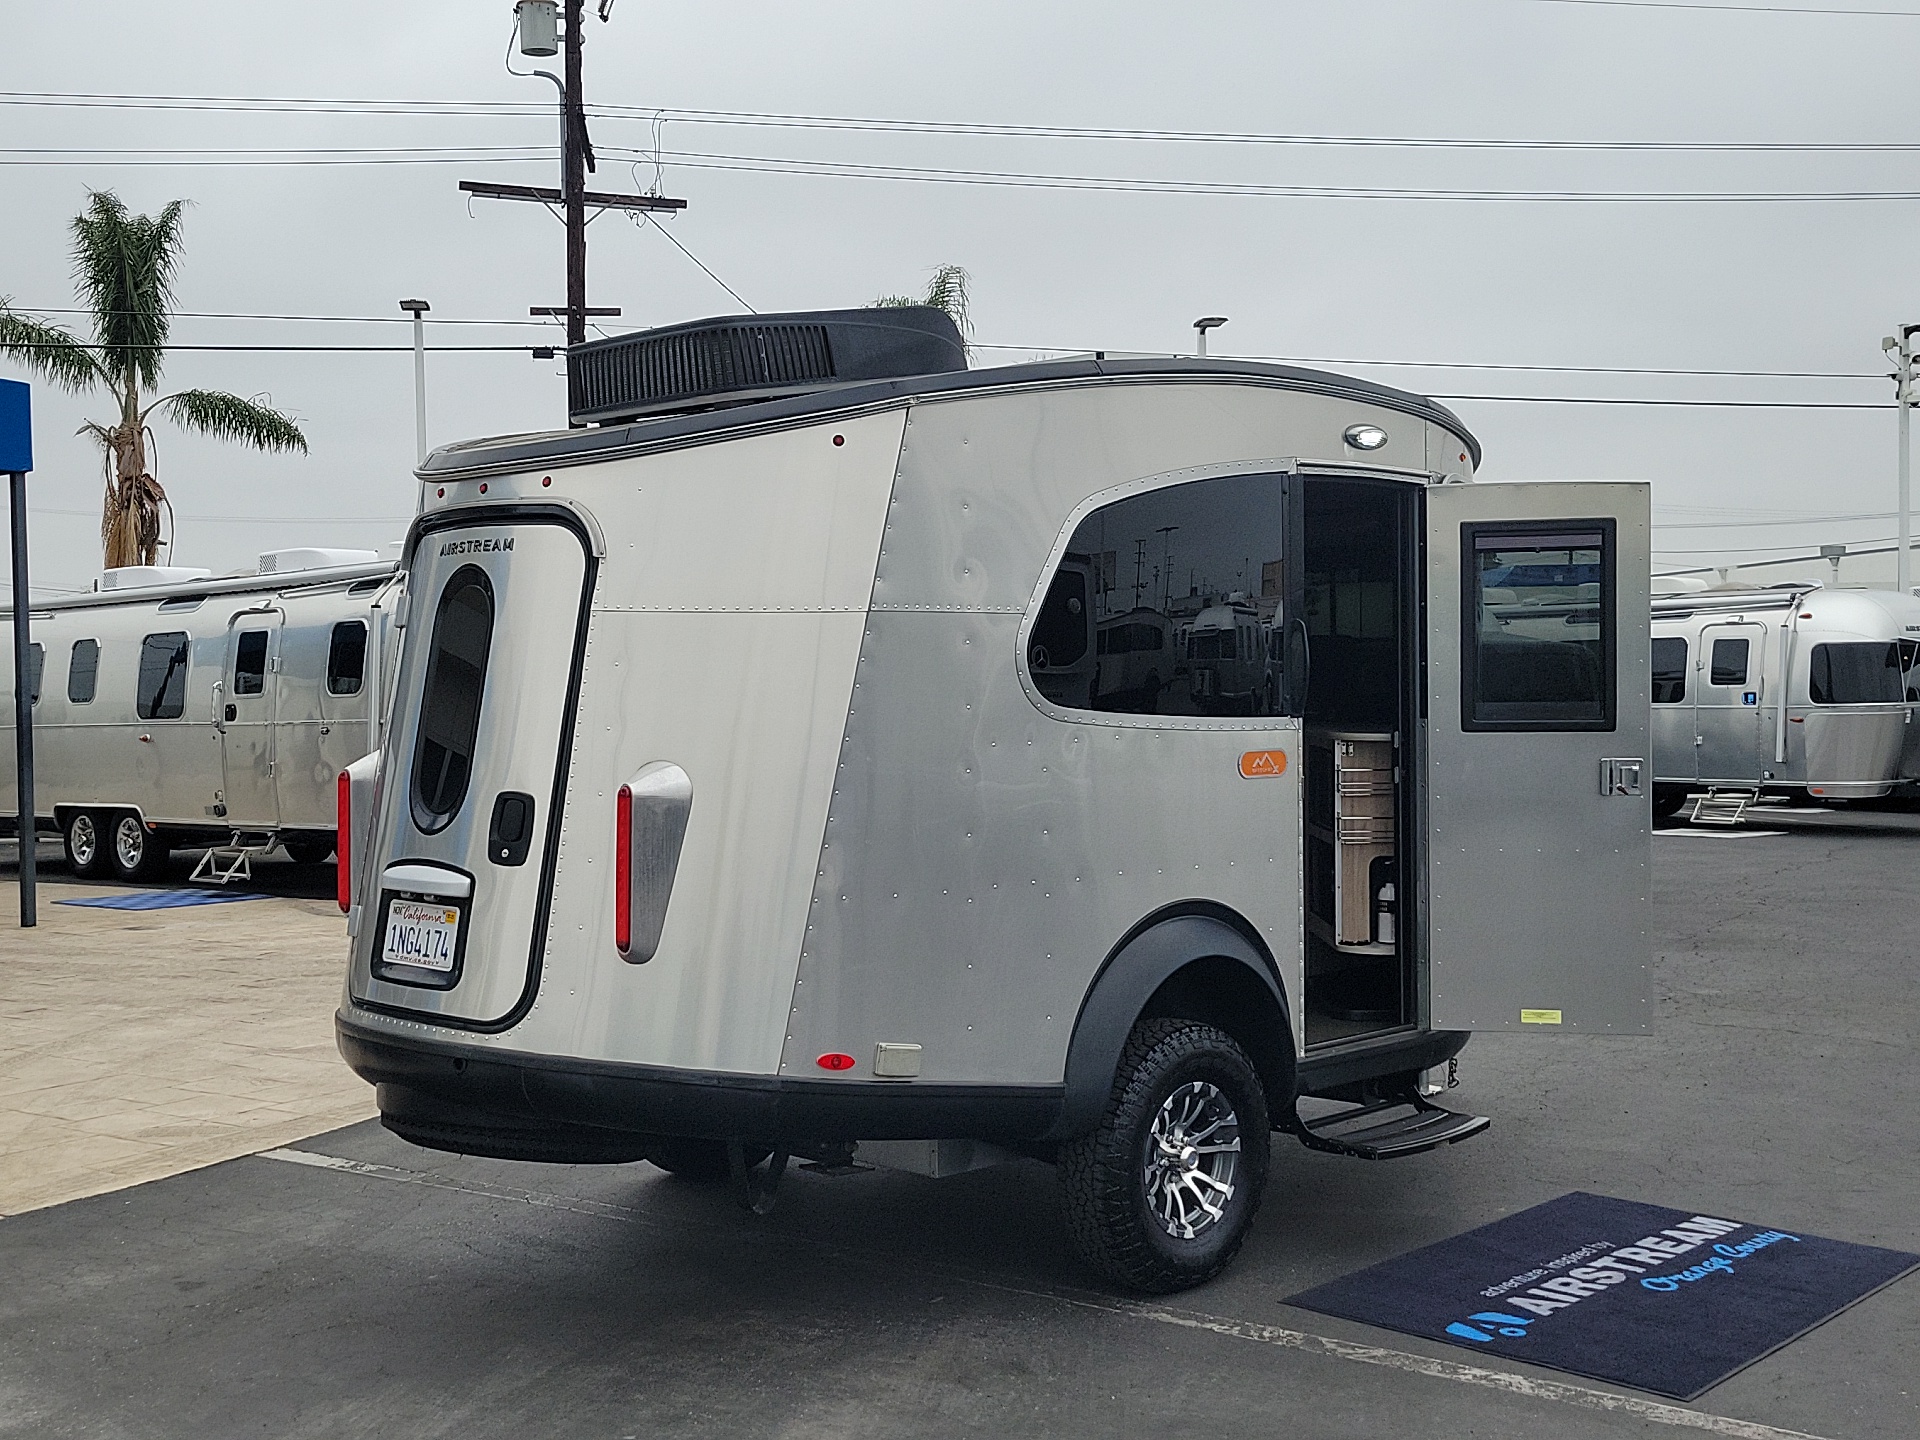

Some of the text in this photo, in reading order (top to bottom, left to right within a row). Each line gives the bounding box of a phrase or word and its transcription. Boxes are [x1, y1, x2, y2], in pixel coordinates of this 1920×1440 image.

[440, 538, 515, 557] AIRSTREAM
[403, 905, 446, 926] California
[388, 924, 449, 961] 1NG4174
[1506, 1215, 1744, 1317] AIRSTREAM
[1540, 1246, 1598, 1269] inspired
[1585, 1241, 1617, 1250] by
[1640, 1230, 1801, 1291] Orange County
